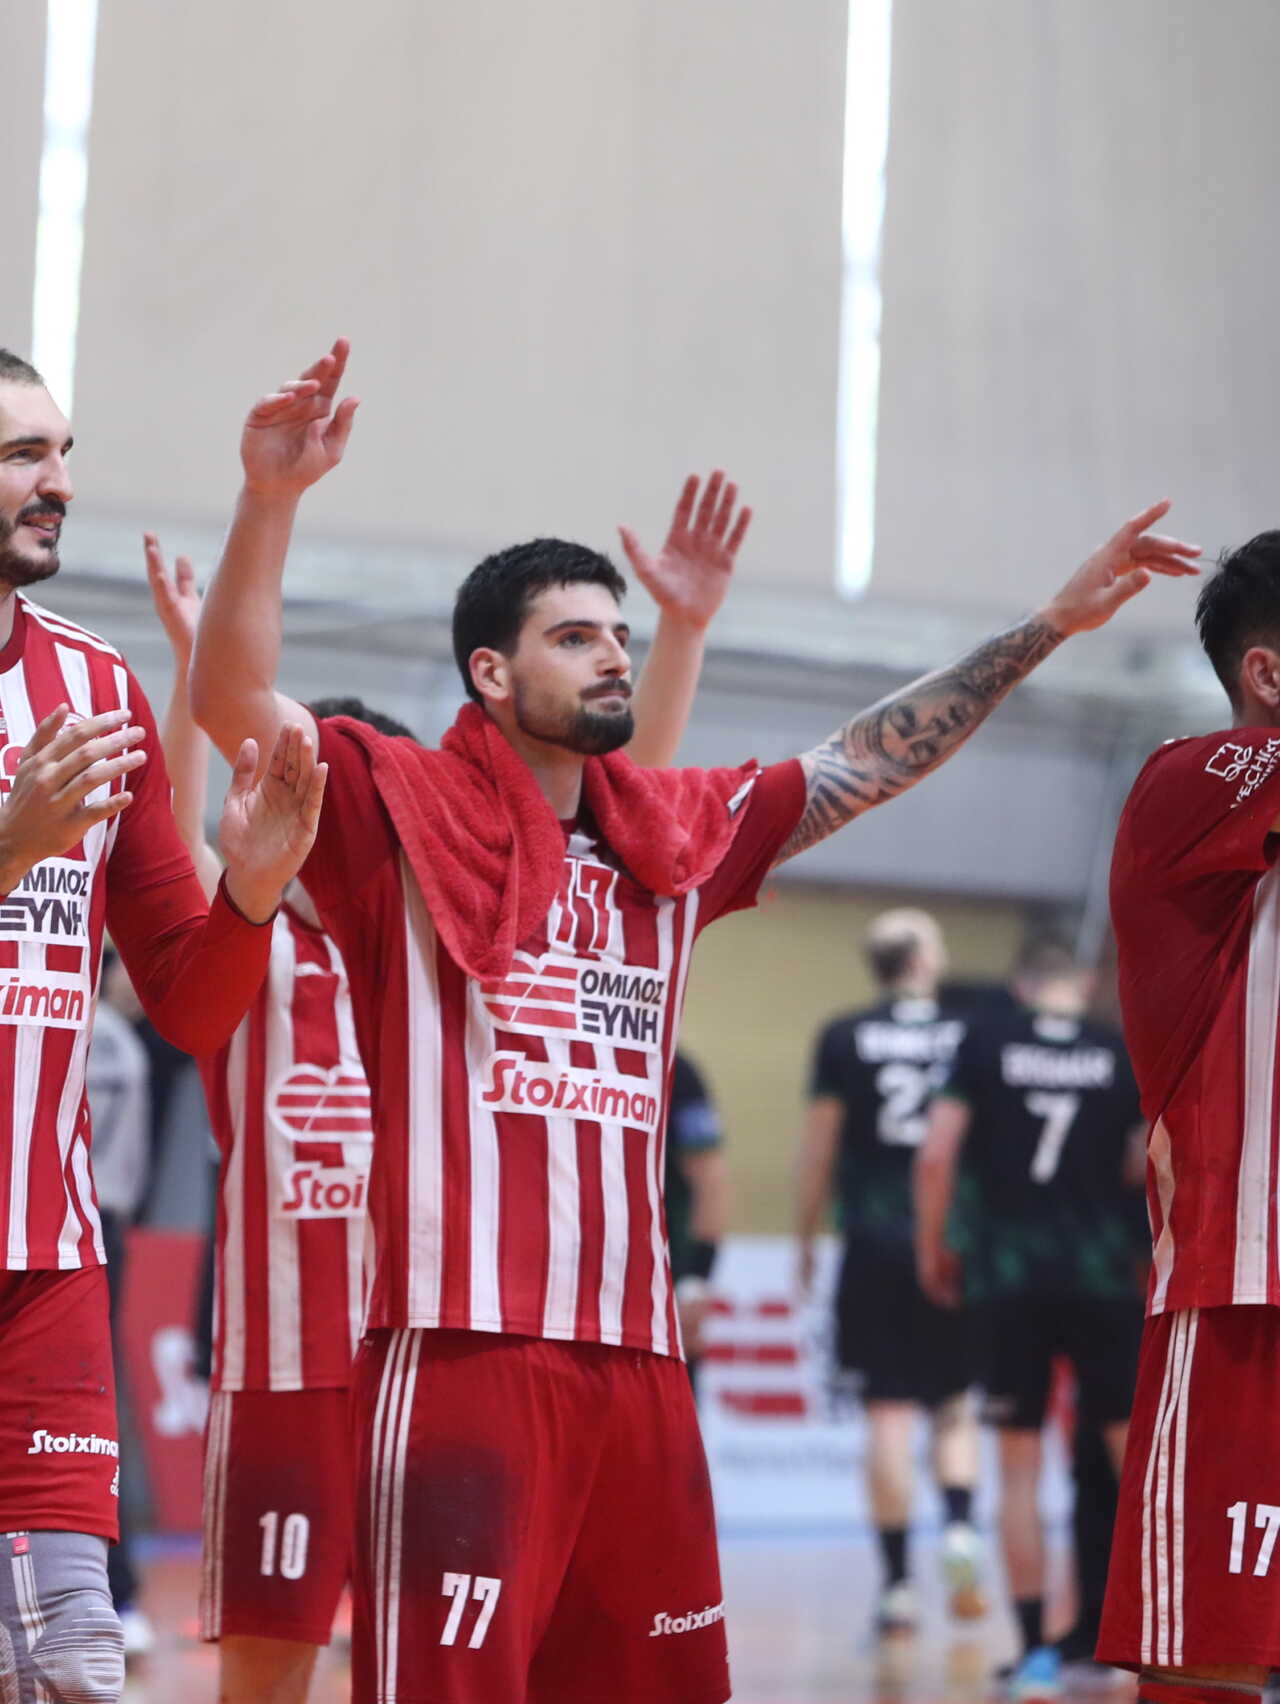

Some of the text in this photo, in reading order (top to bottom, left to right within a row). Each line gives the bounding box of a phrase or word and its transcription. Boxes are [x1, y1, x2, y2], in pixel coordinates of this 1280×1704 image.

[22, 866, 91, 897] ΜΙΛΟΣ
[580, 999, 659, 1044] ΞΥΝΗ
[581, 969, 665, 1006] ΟΜΙΛΟΣ
[482, 1058, 657, 1127] Stoiximan
[1024, 1090, 1080, 1183] 7
[27, 1429, 119, 1459] Stoixima
[259, 1511, 310, 1580] 10
[1226, 1501, 1280, 1577] 17
[439, 1572, 502, 1650] 77
